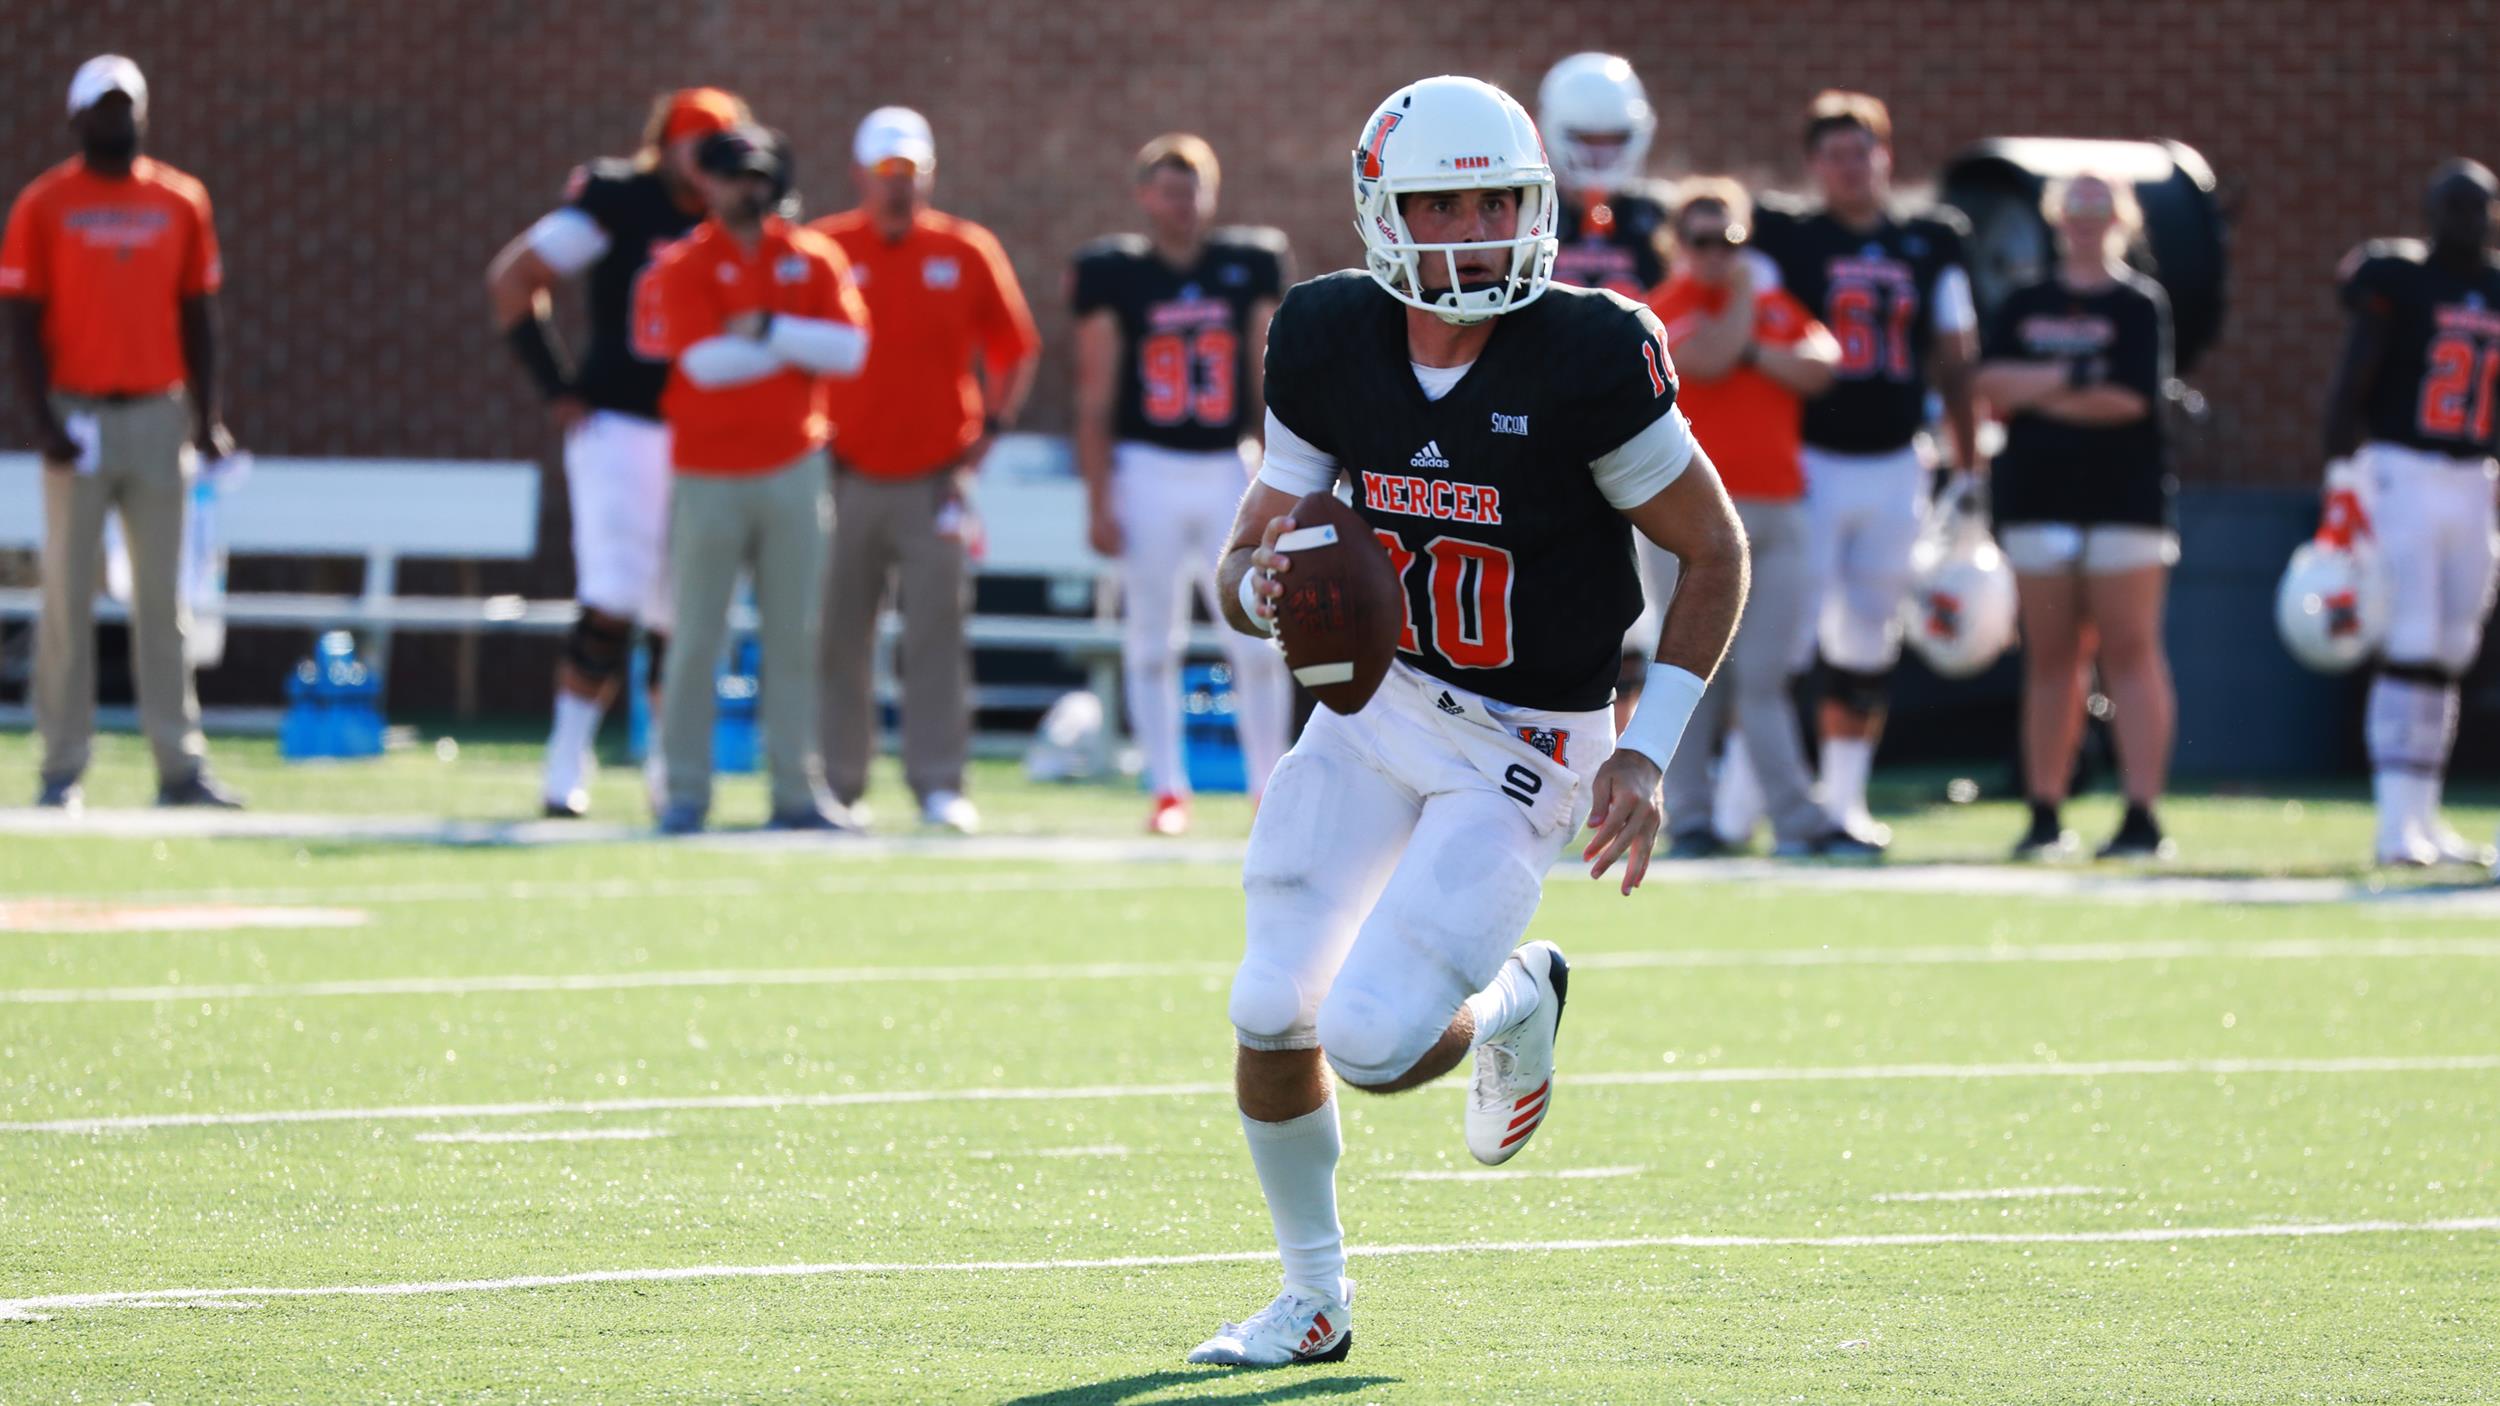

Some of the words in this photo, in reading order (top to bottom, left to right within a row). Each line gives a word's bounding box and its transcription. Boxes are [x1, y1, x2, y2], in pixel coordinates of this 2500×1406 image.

[1376, 216, 1399, 244] Ridde
[1141, 328, 1239, 425] 93
[1491, 412, 1529, 436] SOCON
[1410, 456, 1450, 468] adidas
[1362, 470, 1503, 525] MERCER
[1501, 763, 1543, 807] 10
